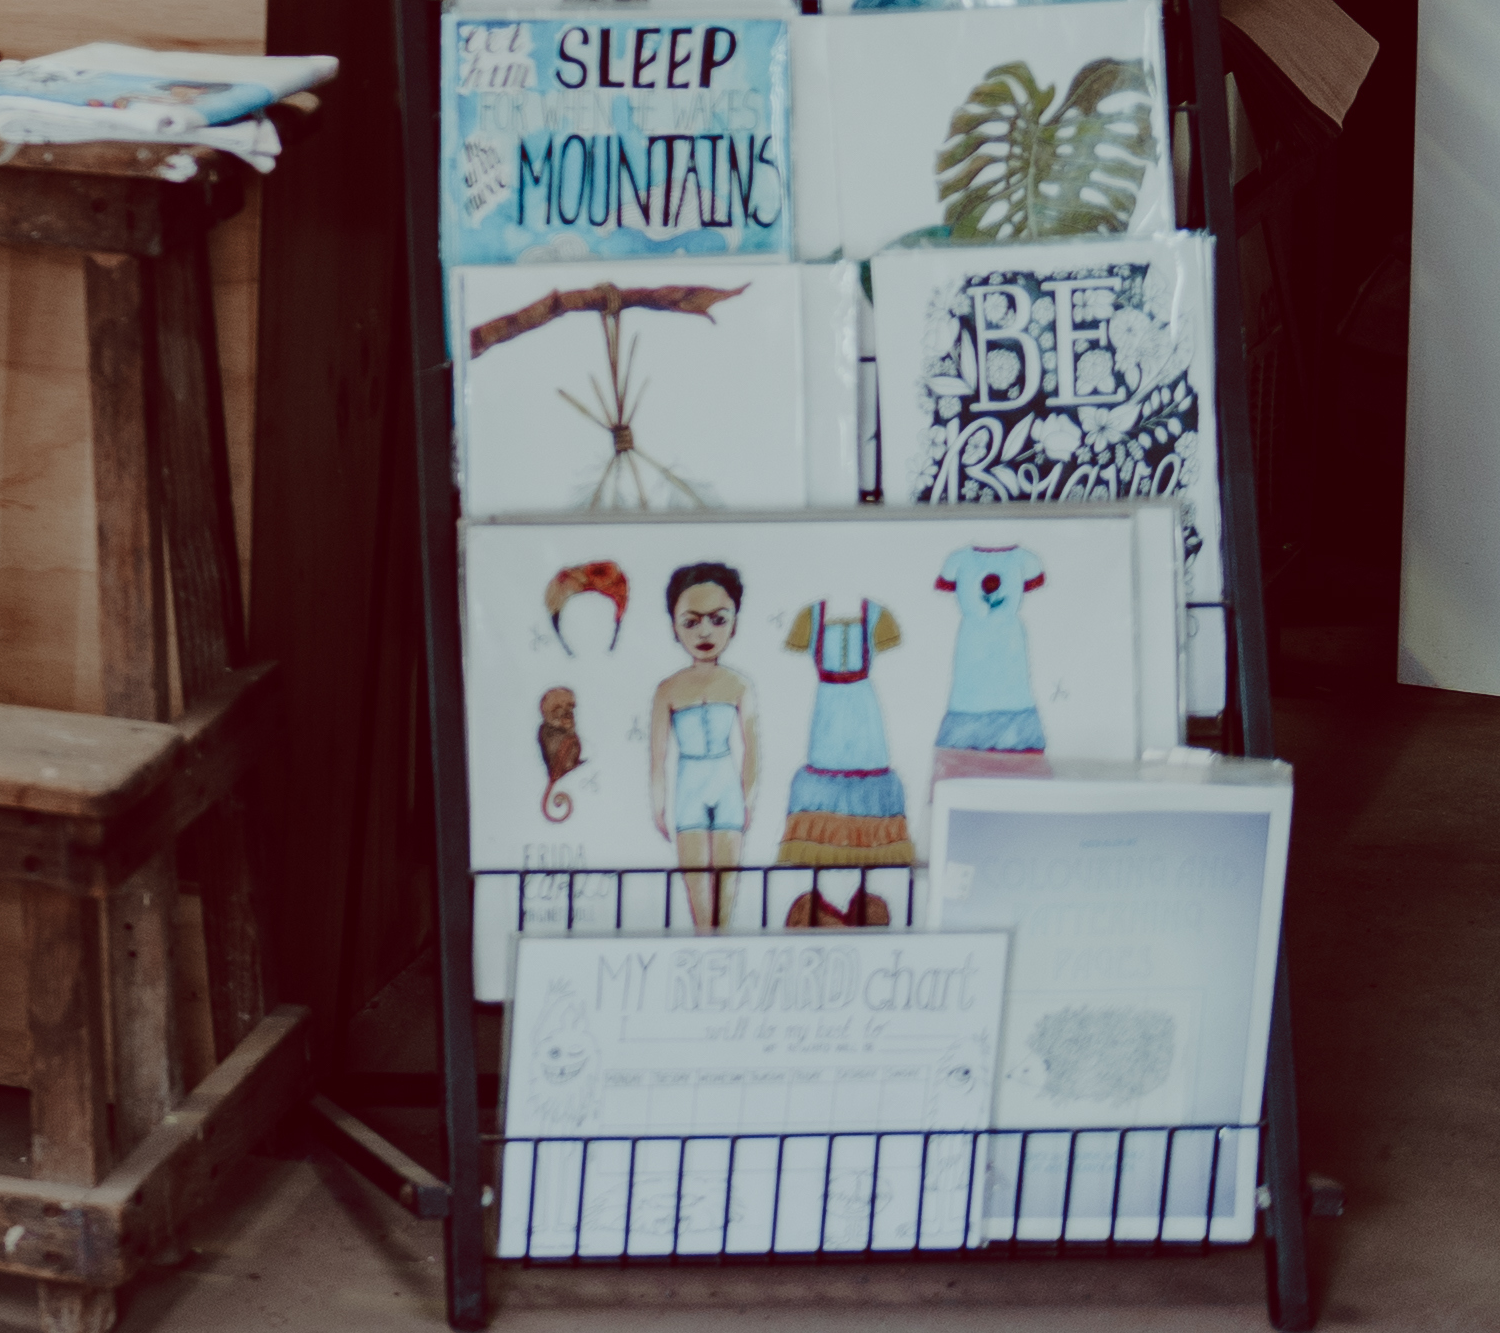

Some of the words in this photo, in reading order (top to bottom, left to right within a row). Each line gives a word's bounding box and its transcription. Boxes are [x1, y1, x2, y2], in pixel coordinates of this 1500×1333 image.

[556, 27, 737, 89] SLEEP
[516, 134, 784, 228] MOUNTAINS
[967, 277, 1127, 413] BE
